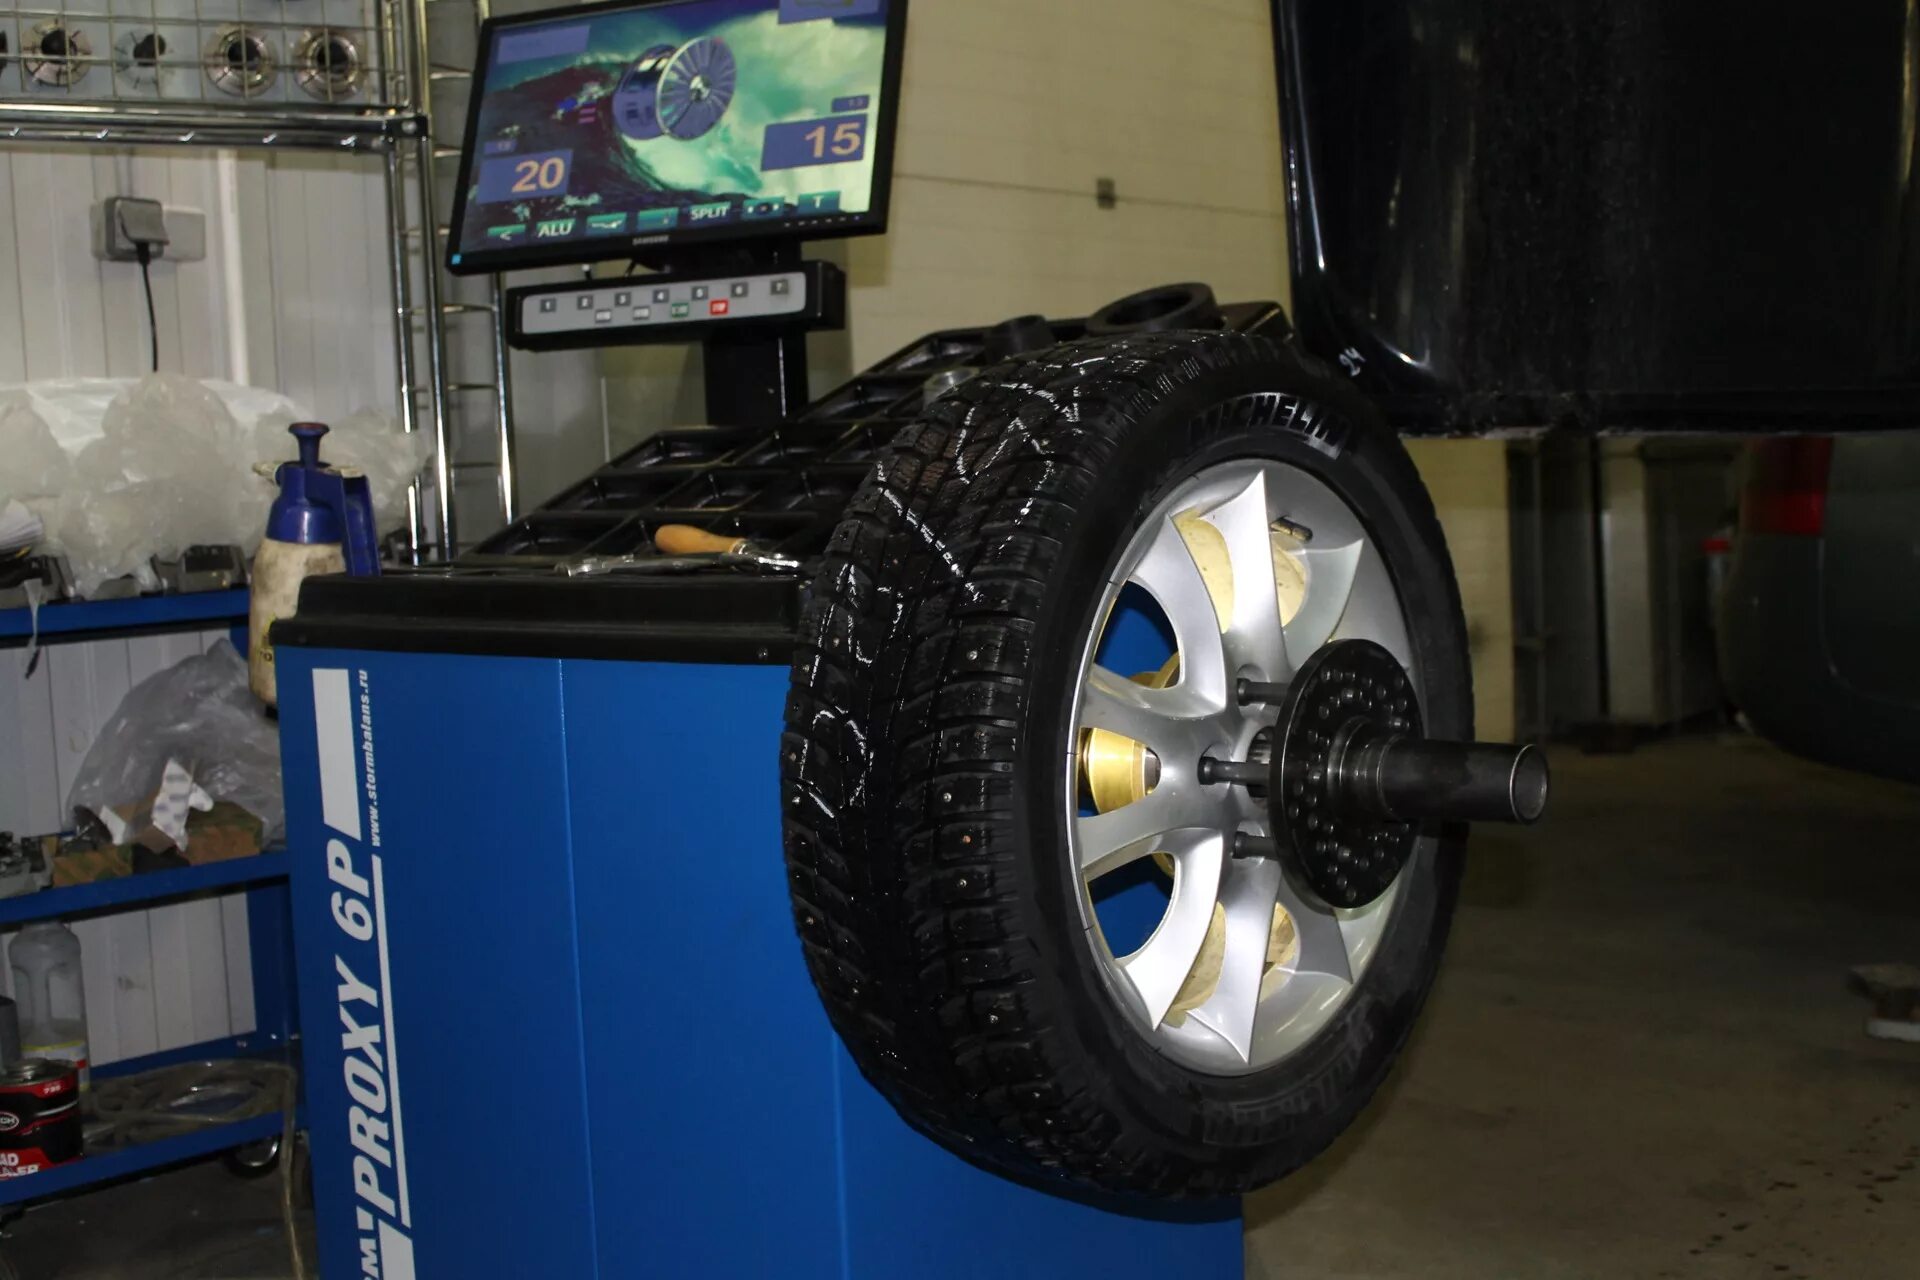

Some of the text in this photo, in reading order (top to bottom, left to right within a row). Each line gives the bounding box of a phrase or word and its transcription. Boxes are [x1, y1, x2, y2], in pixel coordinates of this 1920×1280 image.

[804, 121, 862, 159] 15
[511, 156, 565, 193] 20
[537, 220, 574, 239] ALU
[690, 204, 729, 221] SPLIT
[1188, 393, 1350, 451] MICHELIN
[358, 669, 381, 847] www.stormbalans.ru
[326, 838, 396, 1219] PROXY 6P
